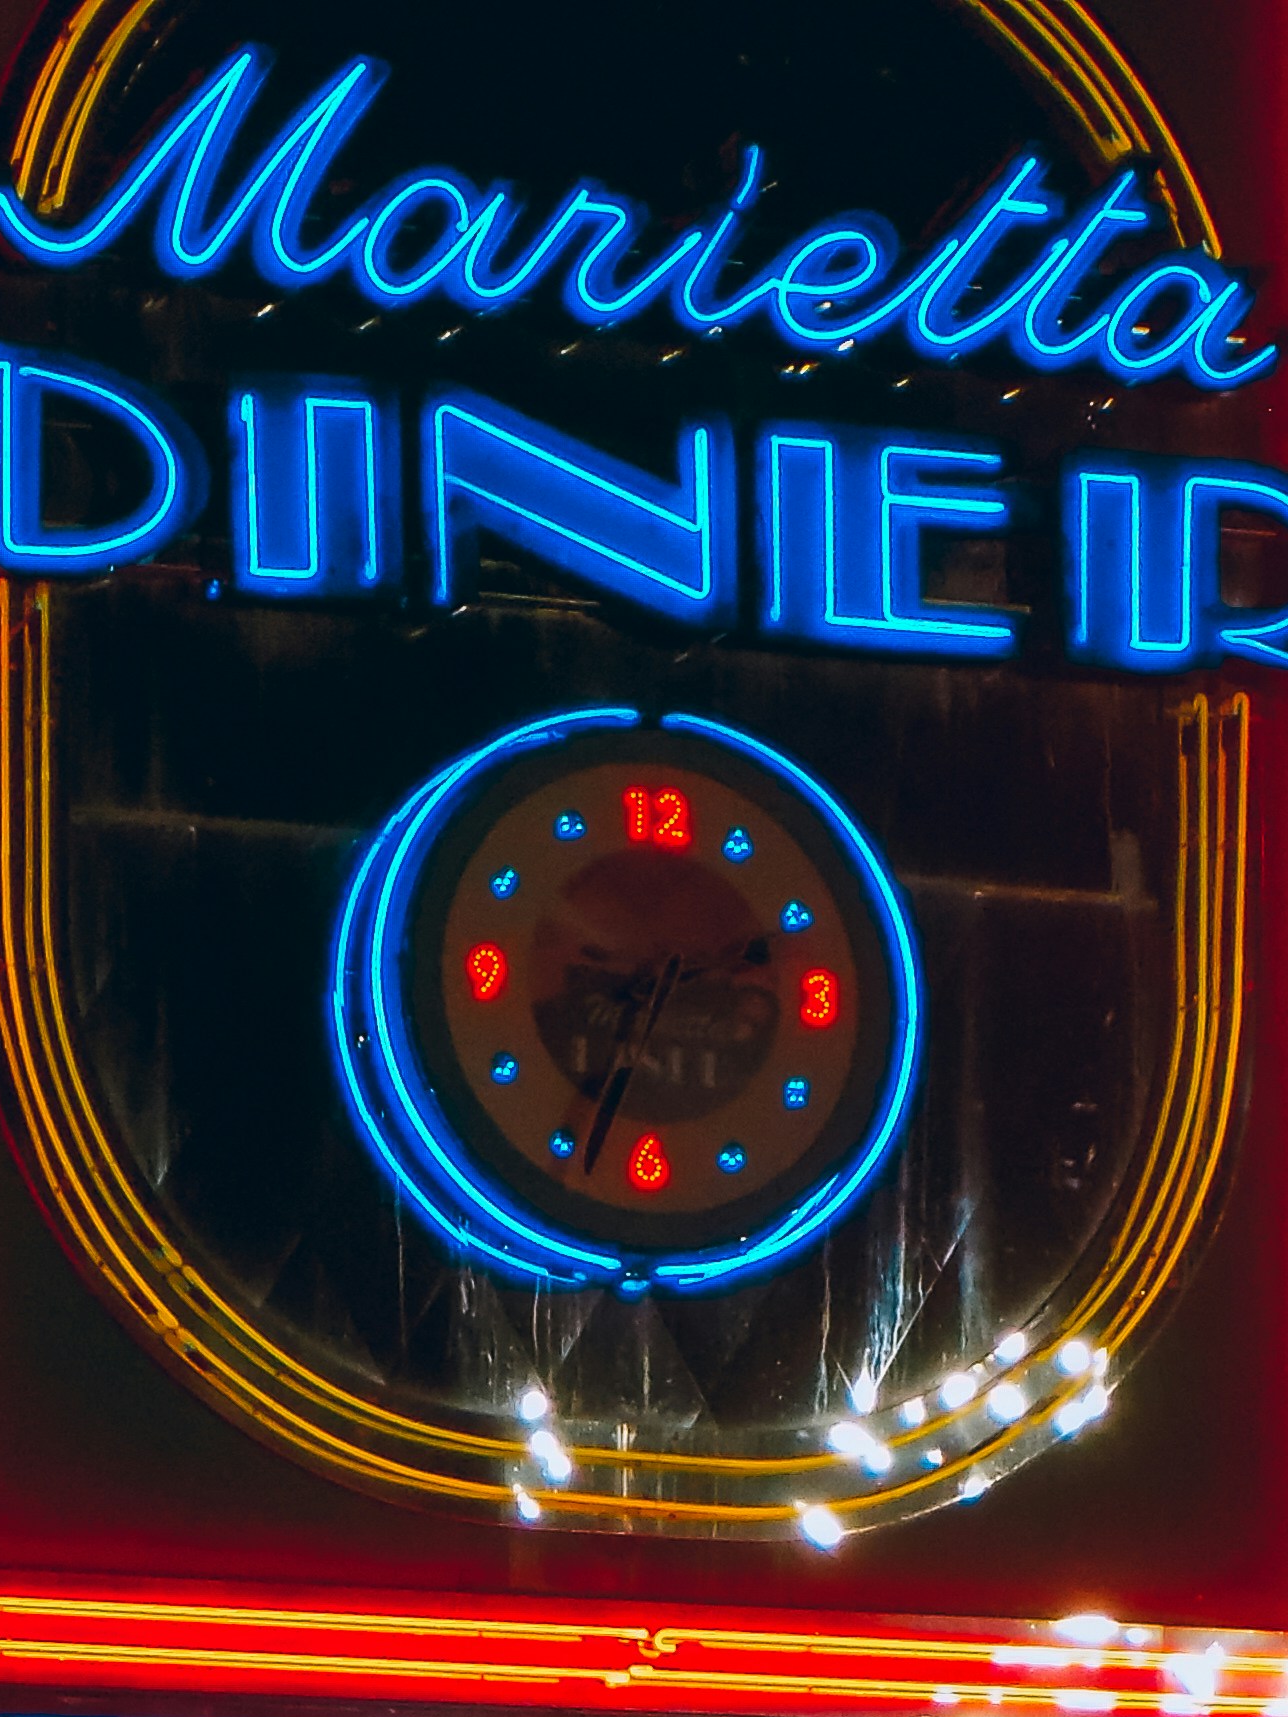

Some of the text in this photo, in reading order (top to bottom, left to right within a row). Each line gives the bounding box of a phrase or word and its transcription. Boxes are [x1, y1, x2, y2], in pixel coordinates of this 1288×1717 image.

[627, 788, 688, 844] 12
[469, 945, 503, 997] 9
[803, 972, 835, 1023] 3
[633, 1136, 664, 1186] 6
